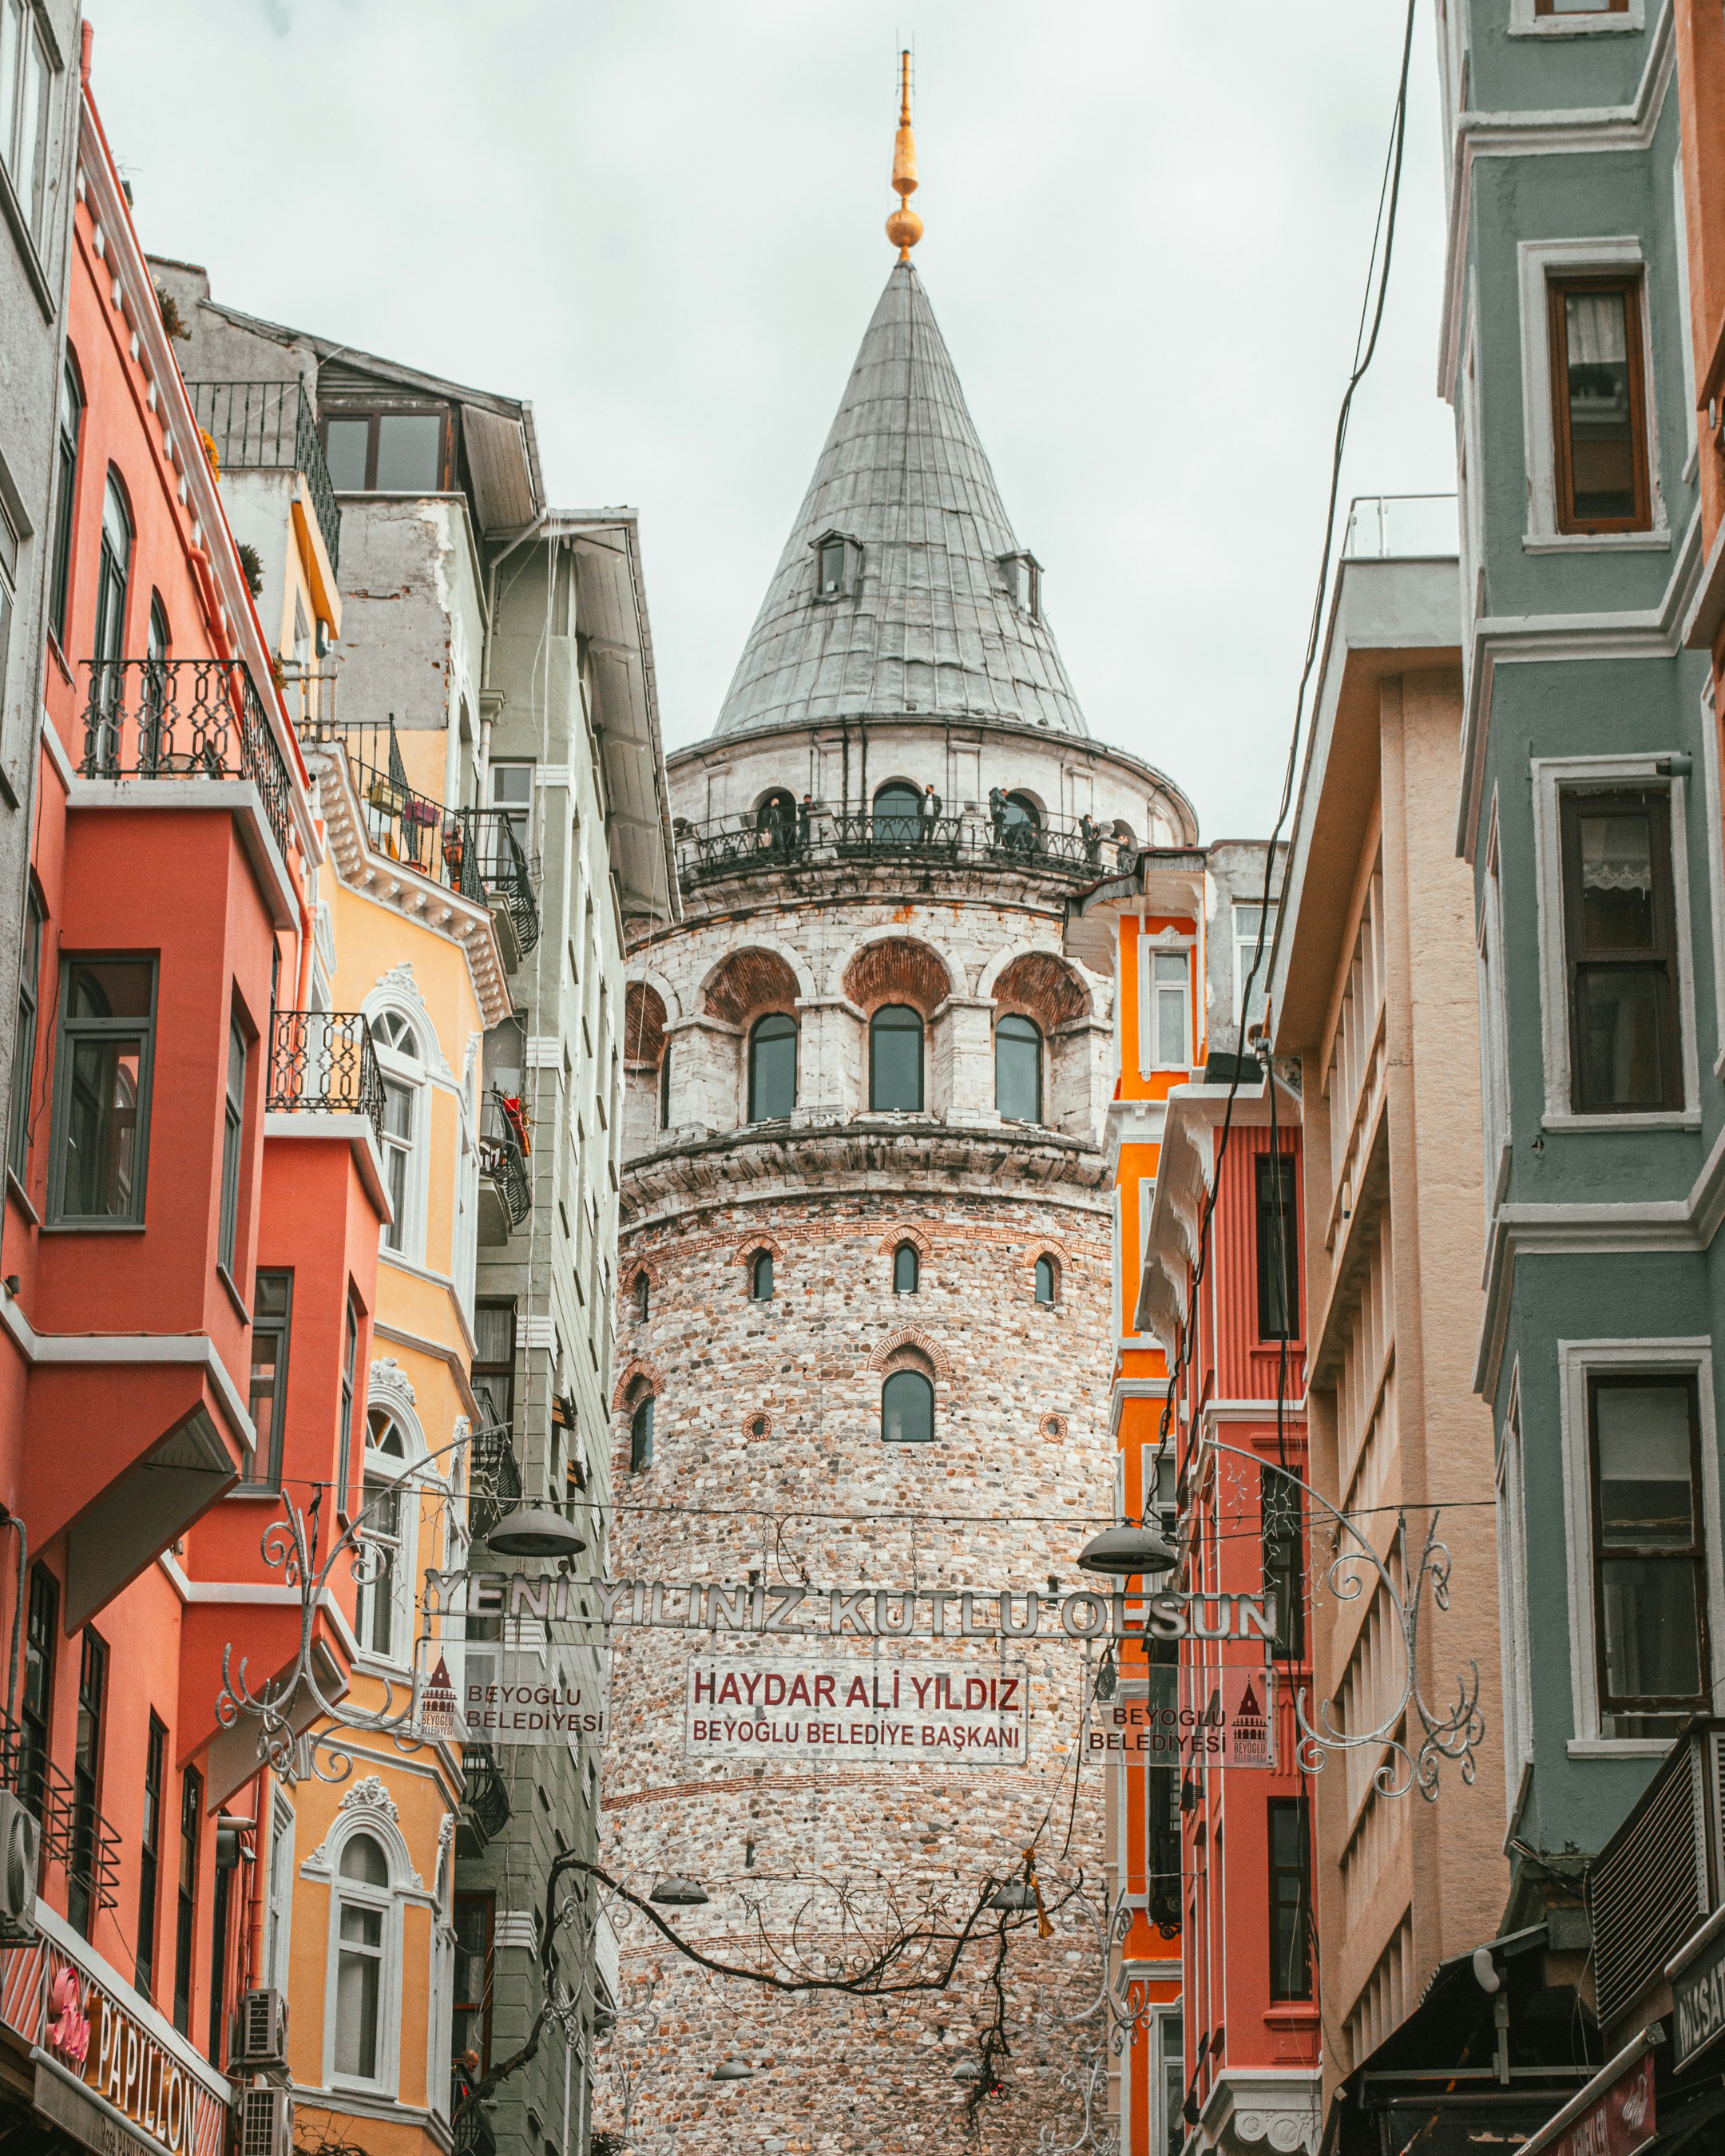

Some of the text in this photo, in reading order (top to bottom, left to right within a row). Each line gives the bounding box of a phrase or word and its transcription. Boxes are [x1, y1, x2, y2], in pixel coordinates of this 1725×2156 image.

[589, 1576, 807, 1634] YILINIZ
[830, 1589, 1038, 1637] KUTLU
[1061, 1591, 1277, 1640] OLSUN
[468, 1682, 581, 1706] BEYOĞLU
[694, 1670, 1019, 1711] HAYDAR ALİ YILDIZ
[466, 1710, 604, 1732] BELEDİYESİ
[1113, 1704, 1226, 1727] BEYOĞLU
[693, 1716, 1019, 1752] BEYOĞLU BELEDİYE BAŞKANI
[1089, 1731, 1226, 1754] BELEDİYESİ
[97, 1999, 197, 2156] PAPILLON
